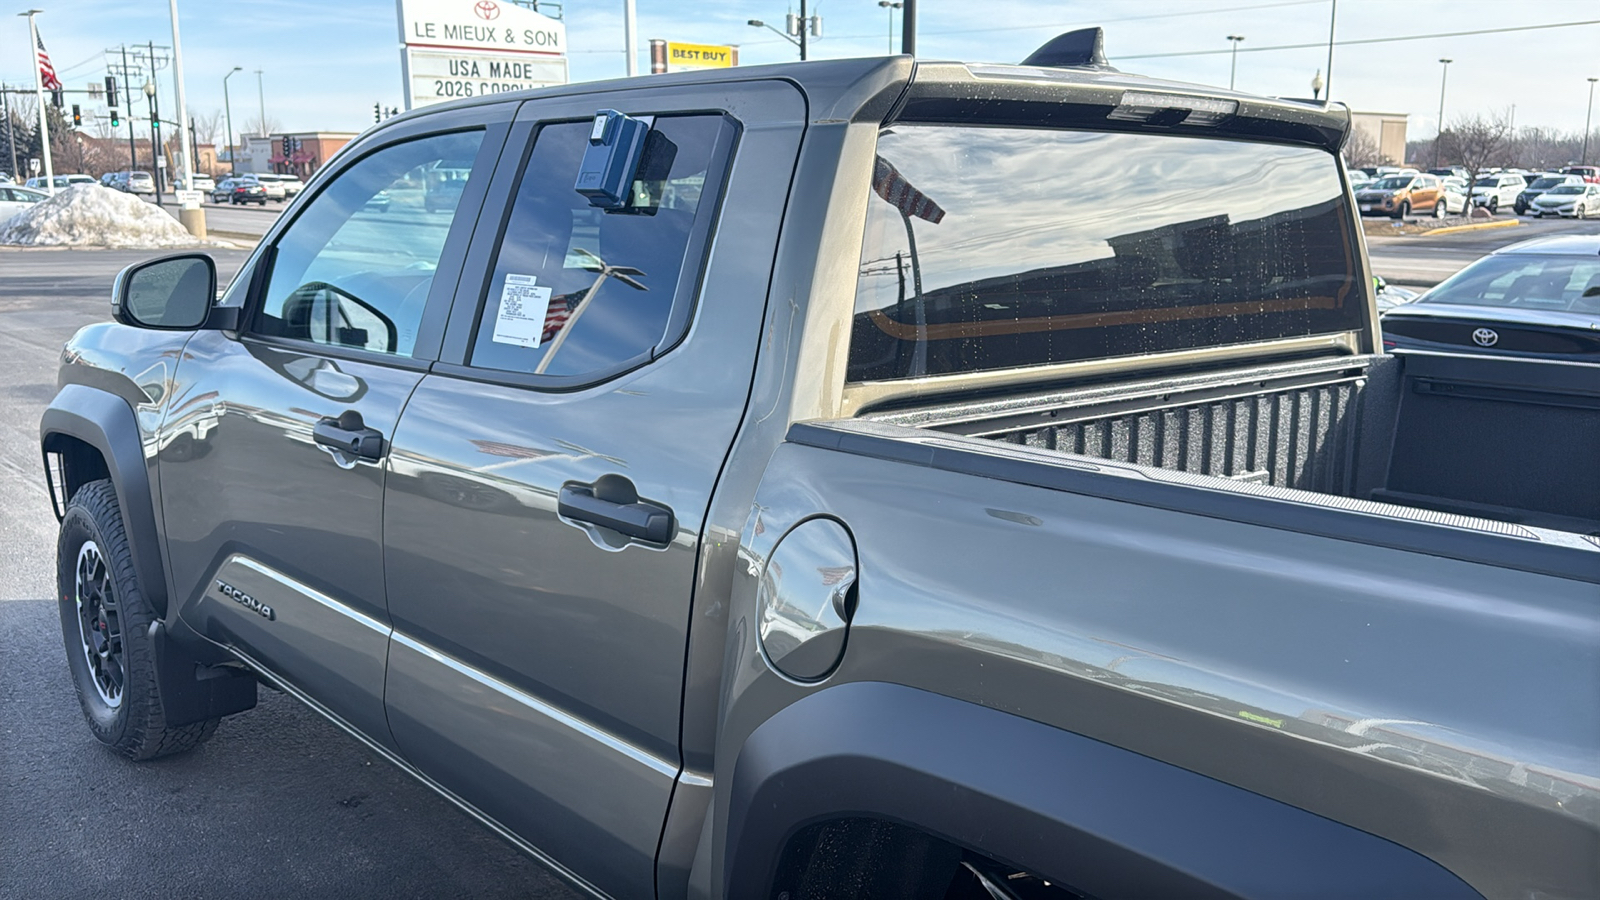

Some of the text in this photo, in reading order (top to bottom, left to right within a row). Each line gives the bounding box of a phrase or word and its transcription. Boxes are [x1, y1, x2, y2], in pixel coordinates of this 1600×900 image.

[415, 22, 558, 47] LE MIEUX & SON
[672, 49, 727, 61] BEST BUY
[449, 59, 533, 79] USA MADE
[435, 80, 473, 97] 2026
[215, 579, 275, 621] TACOMA
